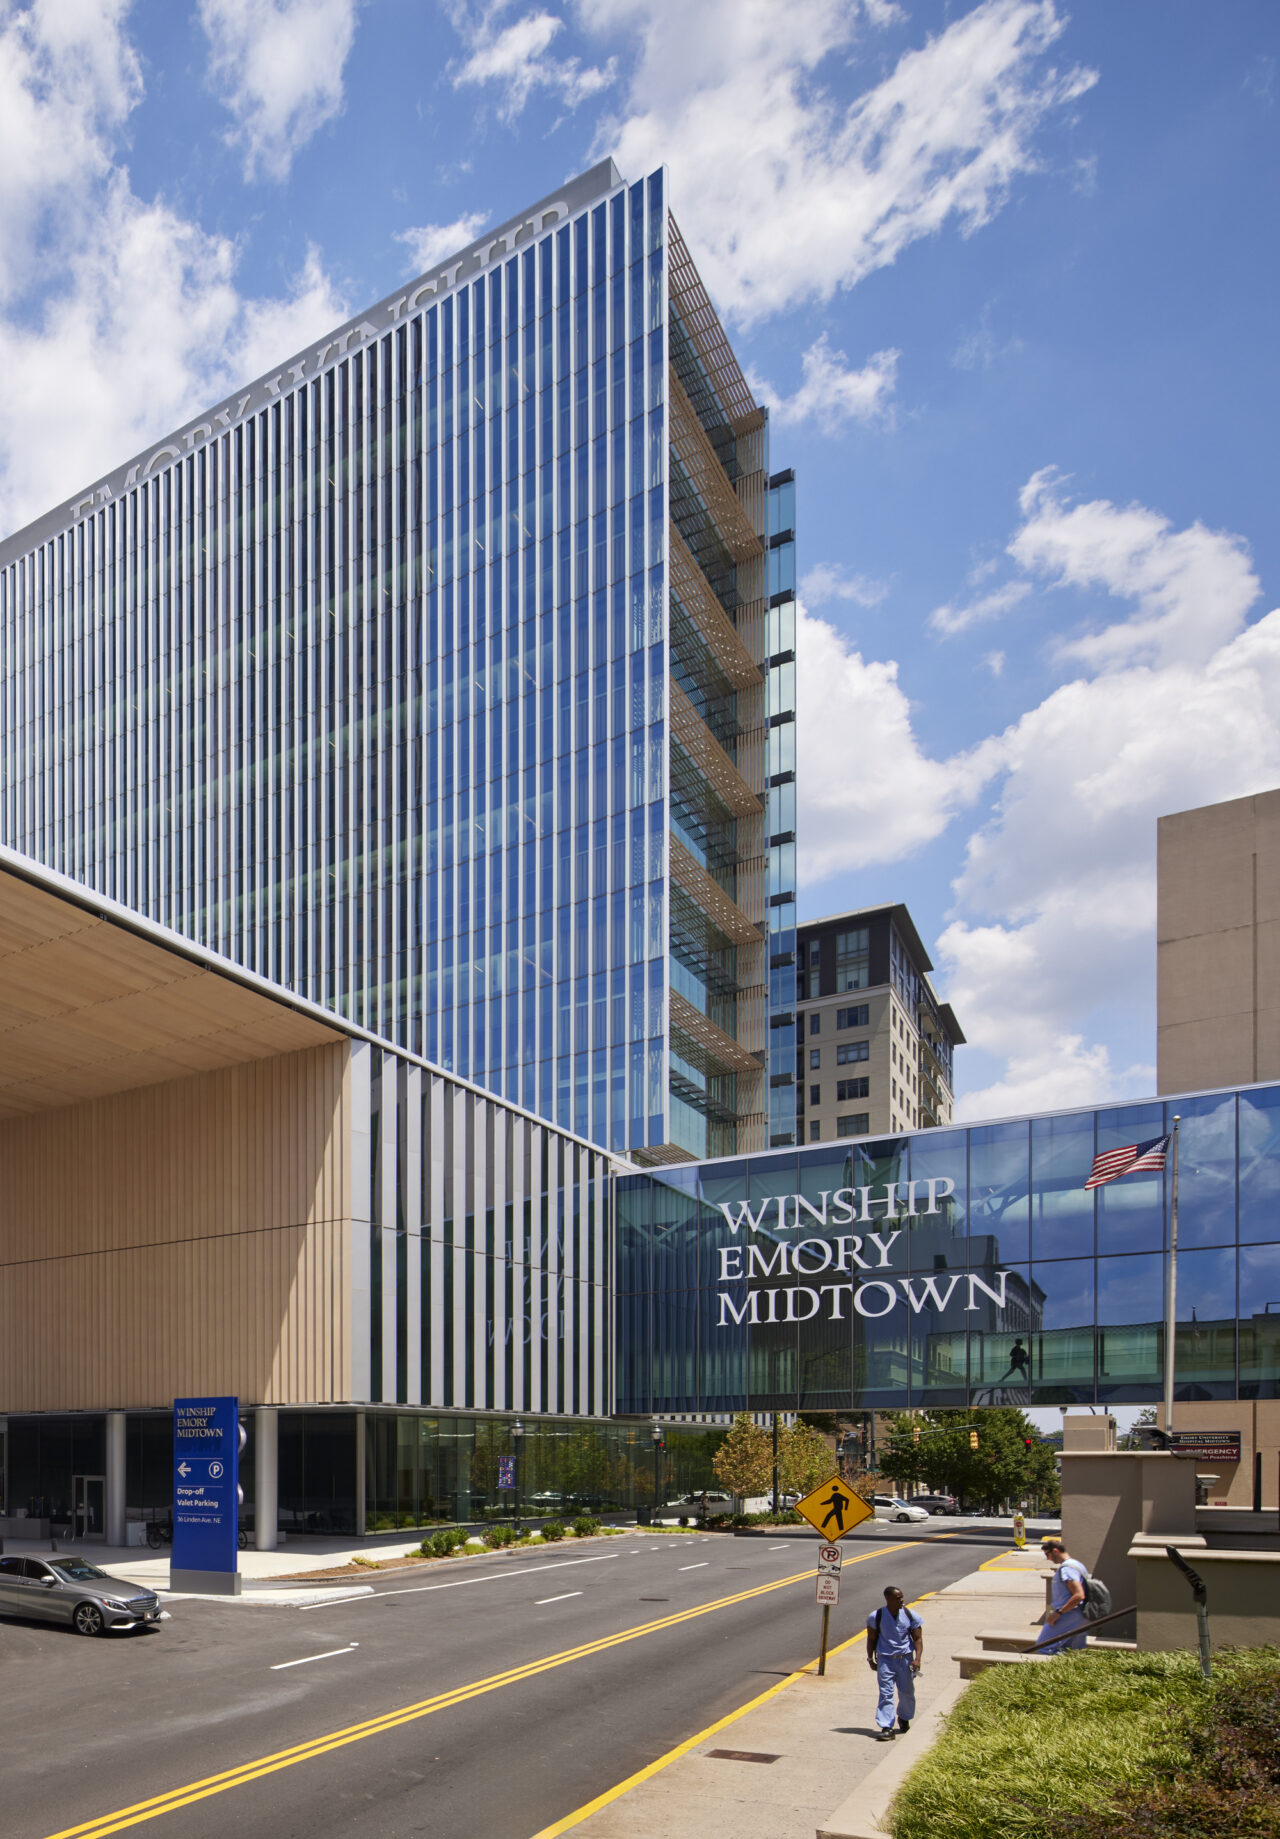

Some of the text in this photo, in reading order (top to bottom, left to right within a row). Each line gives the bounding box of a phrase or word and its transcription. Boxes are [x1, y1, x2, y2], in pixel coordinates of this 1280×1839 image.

[717, 1176, 955, 1235] WINSHIP
[717, 1230, 902, 1281] EMORY
[716, 1270, 1013, 1327] MIDTOWN
[176, 1407, 216, 1417] WINSHIP
[176, 1418, 208, 1427] EMORY
[176, 1428, 223, 1438] MIDTOWN
[213, 1465, 220, 1476] P
[177, 1488, 205, 1496] Drop-off
[177, 1499, 219, 1509] Valet Parking
